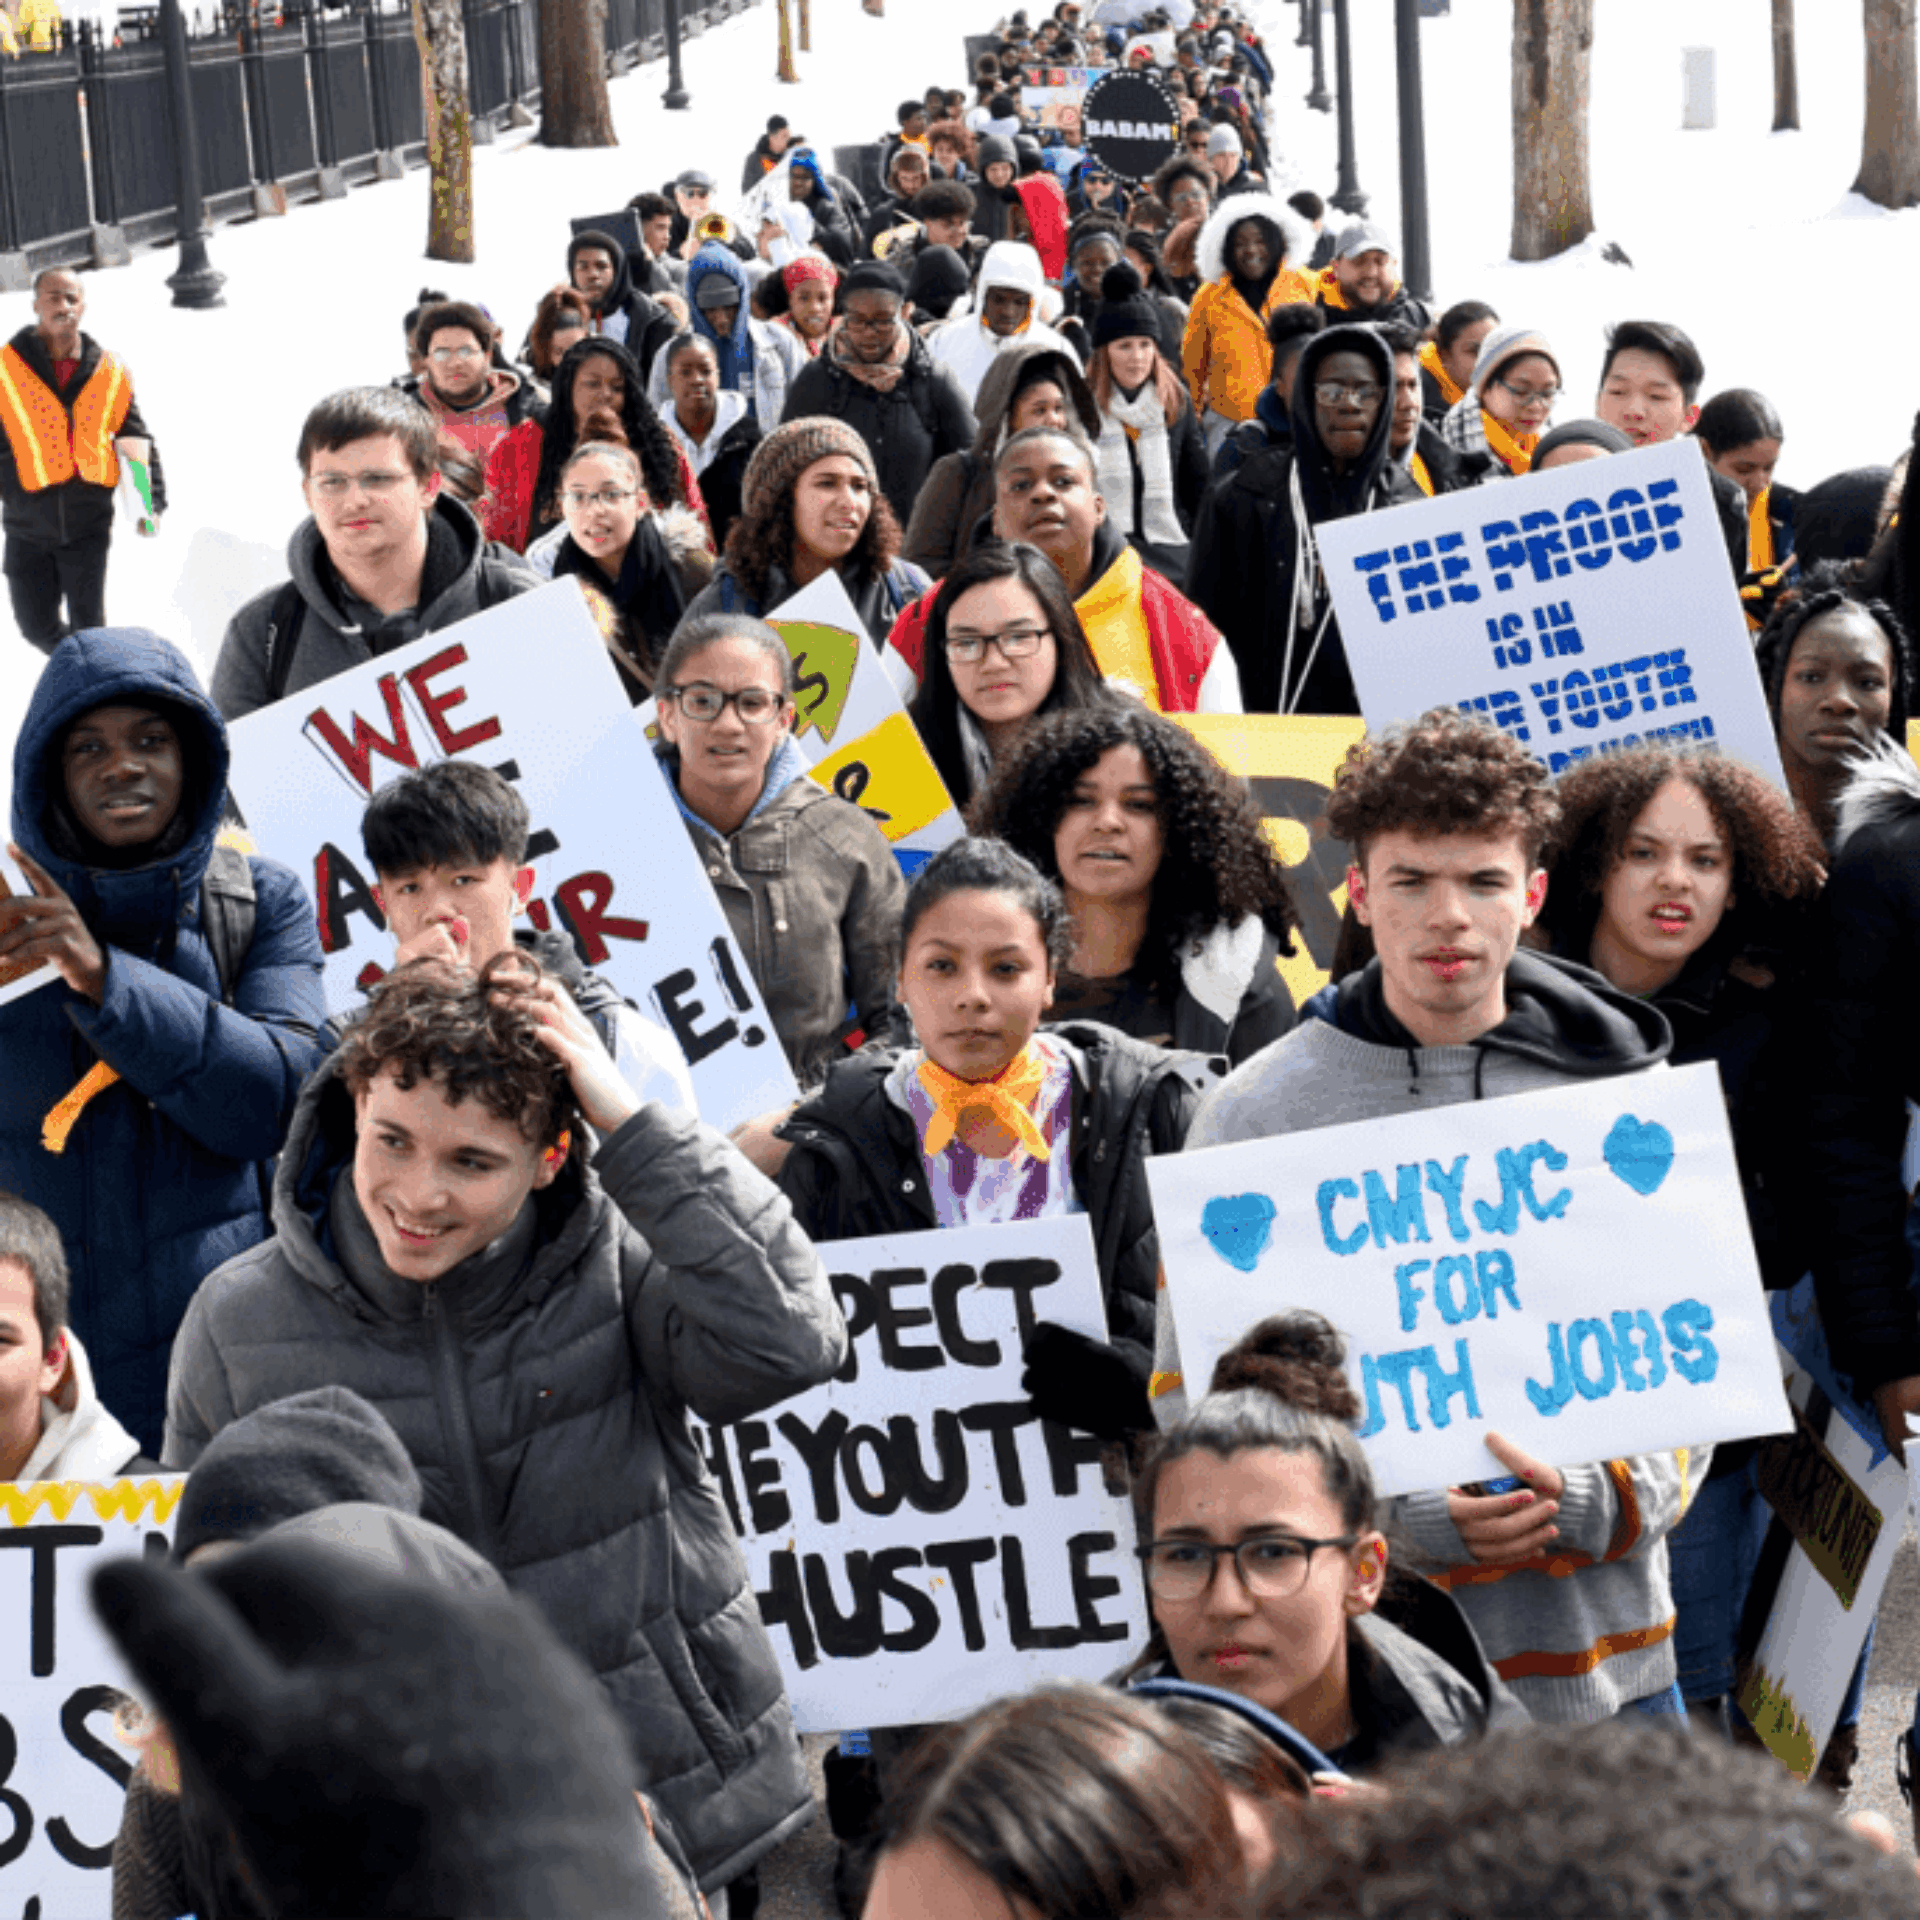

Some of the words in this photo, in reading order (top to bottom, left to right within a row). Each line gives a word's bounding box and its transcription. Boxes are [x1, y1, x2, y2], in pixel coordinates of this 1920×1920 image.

[1086, 119, 1179, 140] BABAM!
[1353, 531, 1481, 623] THE
[1480, 478, 1685, 592] PROOF
[1485, 612, 1533, 669] IS
[1532, 600, 1584, 658] IN
[303, 642, 502, 799] WE
[1529, 648, 1698, 734] YOUTH
[1316, 1139, 1573, 1255] CMYJC
[1394, 1248, 1522, 1332] FOR
[1525, 1299, 1719, 1417] JOBS
